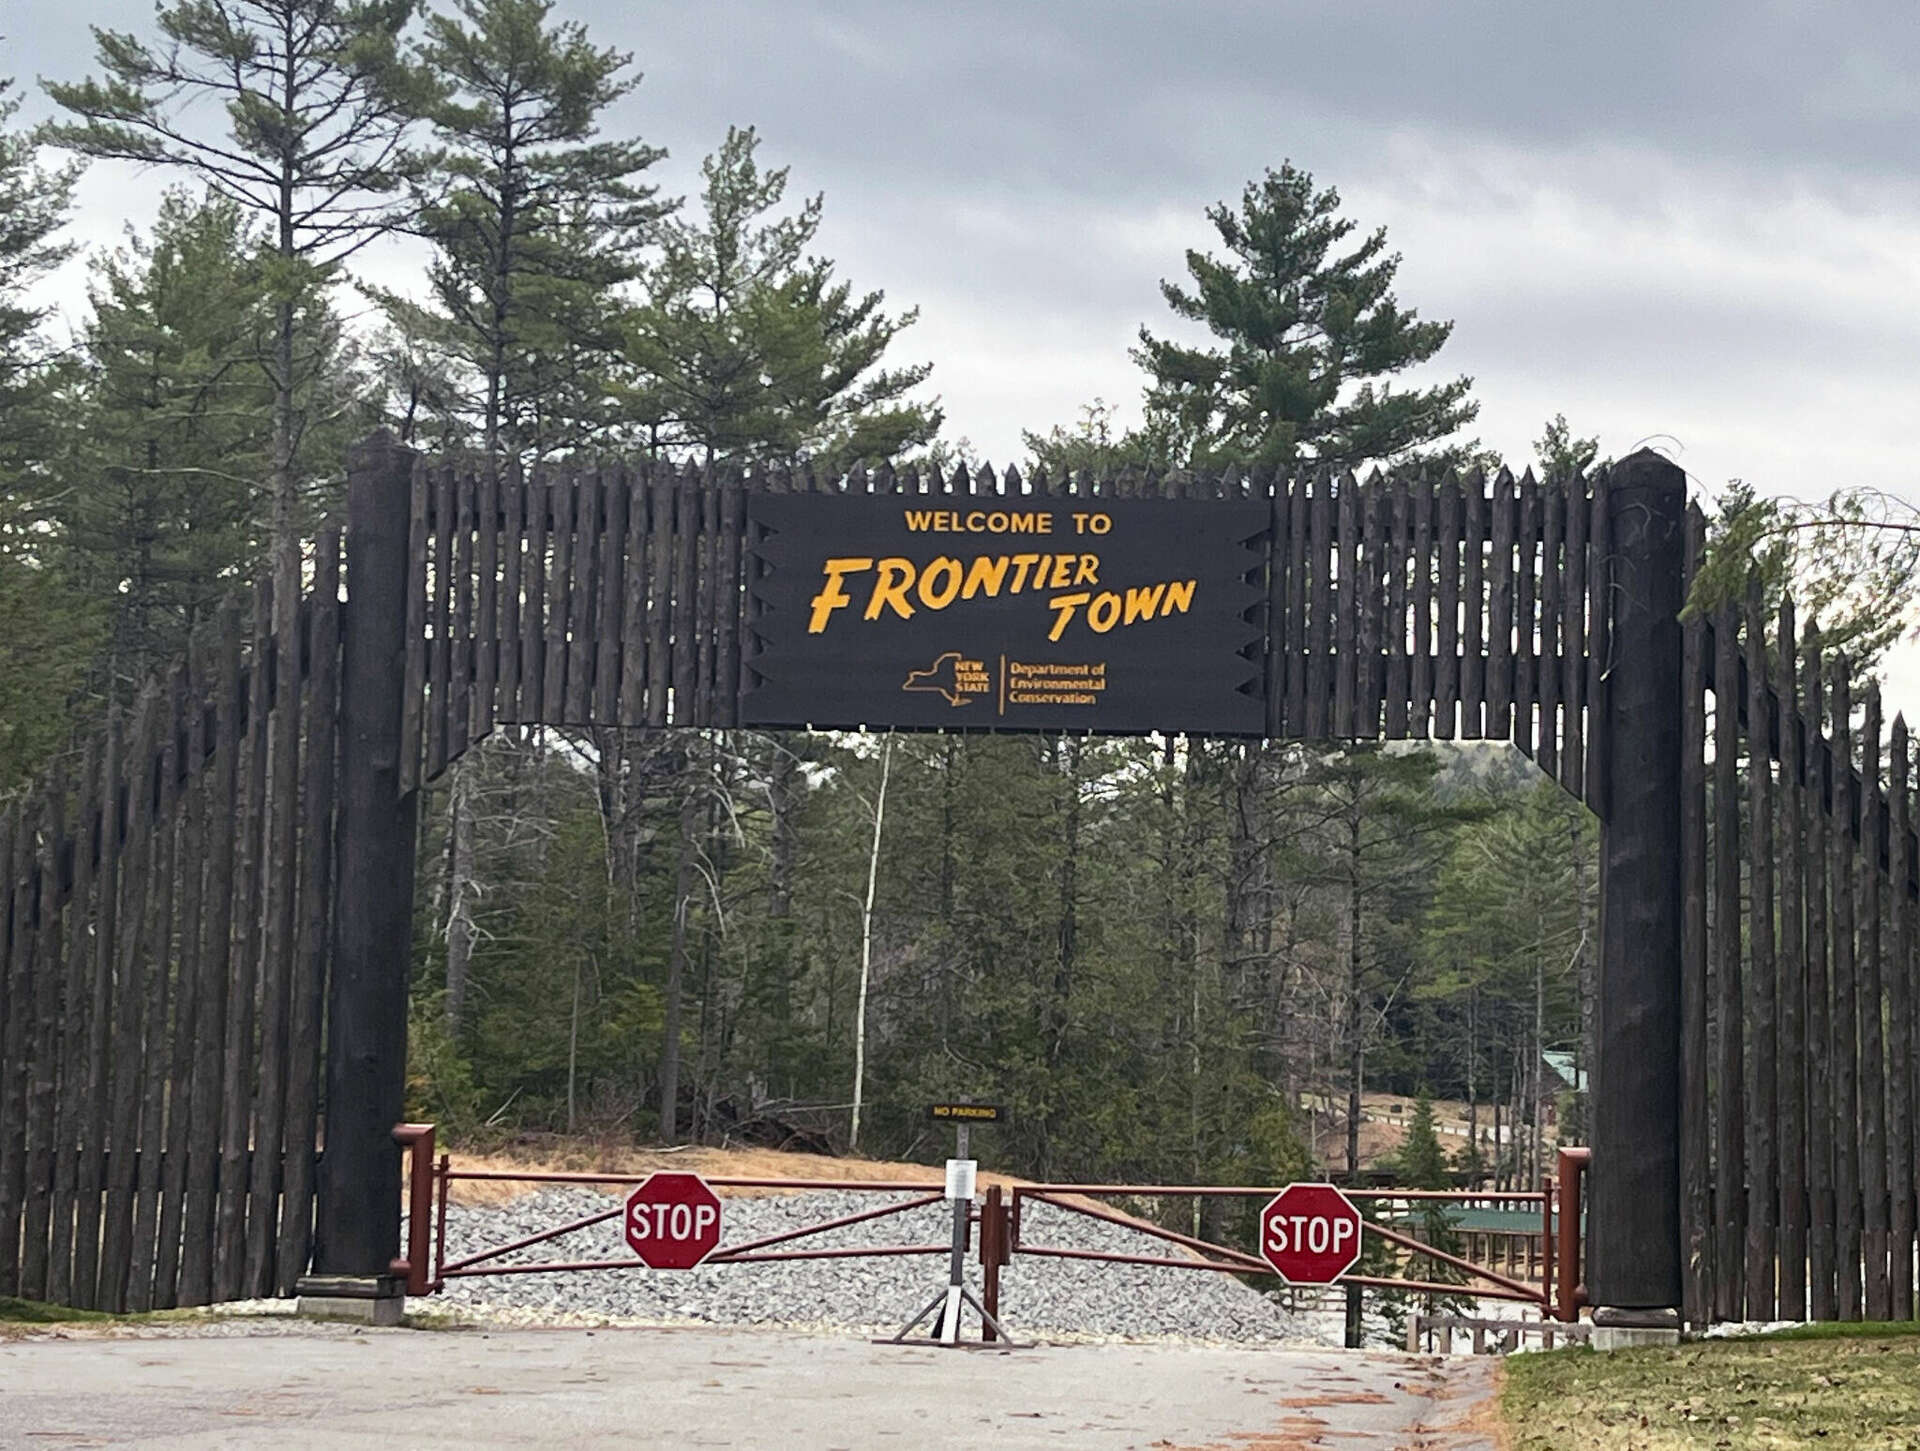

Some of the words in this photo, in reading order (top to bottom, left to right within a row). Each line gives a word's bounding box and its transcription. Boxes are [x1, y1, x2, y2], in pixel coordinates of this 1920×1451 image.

[905, 511, 1053, 534] WELCOME
[1073, 513, 1112, 535] TO
[808, 554, 1100, 634] FRONTIER
[1048, 580, 1196, 642] TOWN
[955, 661, 984, 672] NEW
[1010, 662, 1089, 678] Department
[1091, 663, 1105, 675] of
[956, 672, 989, 682] YORK
[1010, 678, 1105, 690] Environmental
[956, 682, 989, 693] STATE
[1009, 692, 1096, 704] Conservation
[933, 1106, 950, 1116] NO
[951, 1107, 997, 1119] PARKING
[630, 1203, 716, 1240] STOP
[1268, 1215, 1354, 1254] STOP
